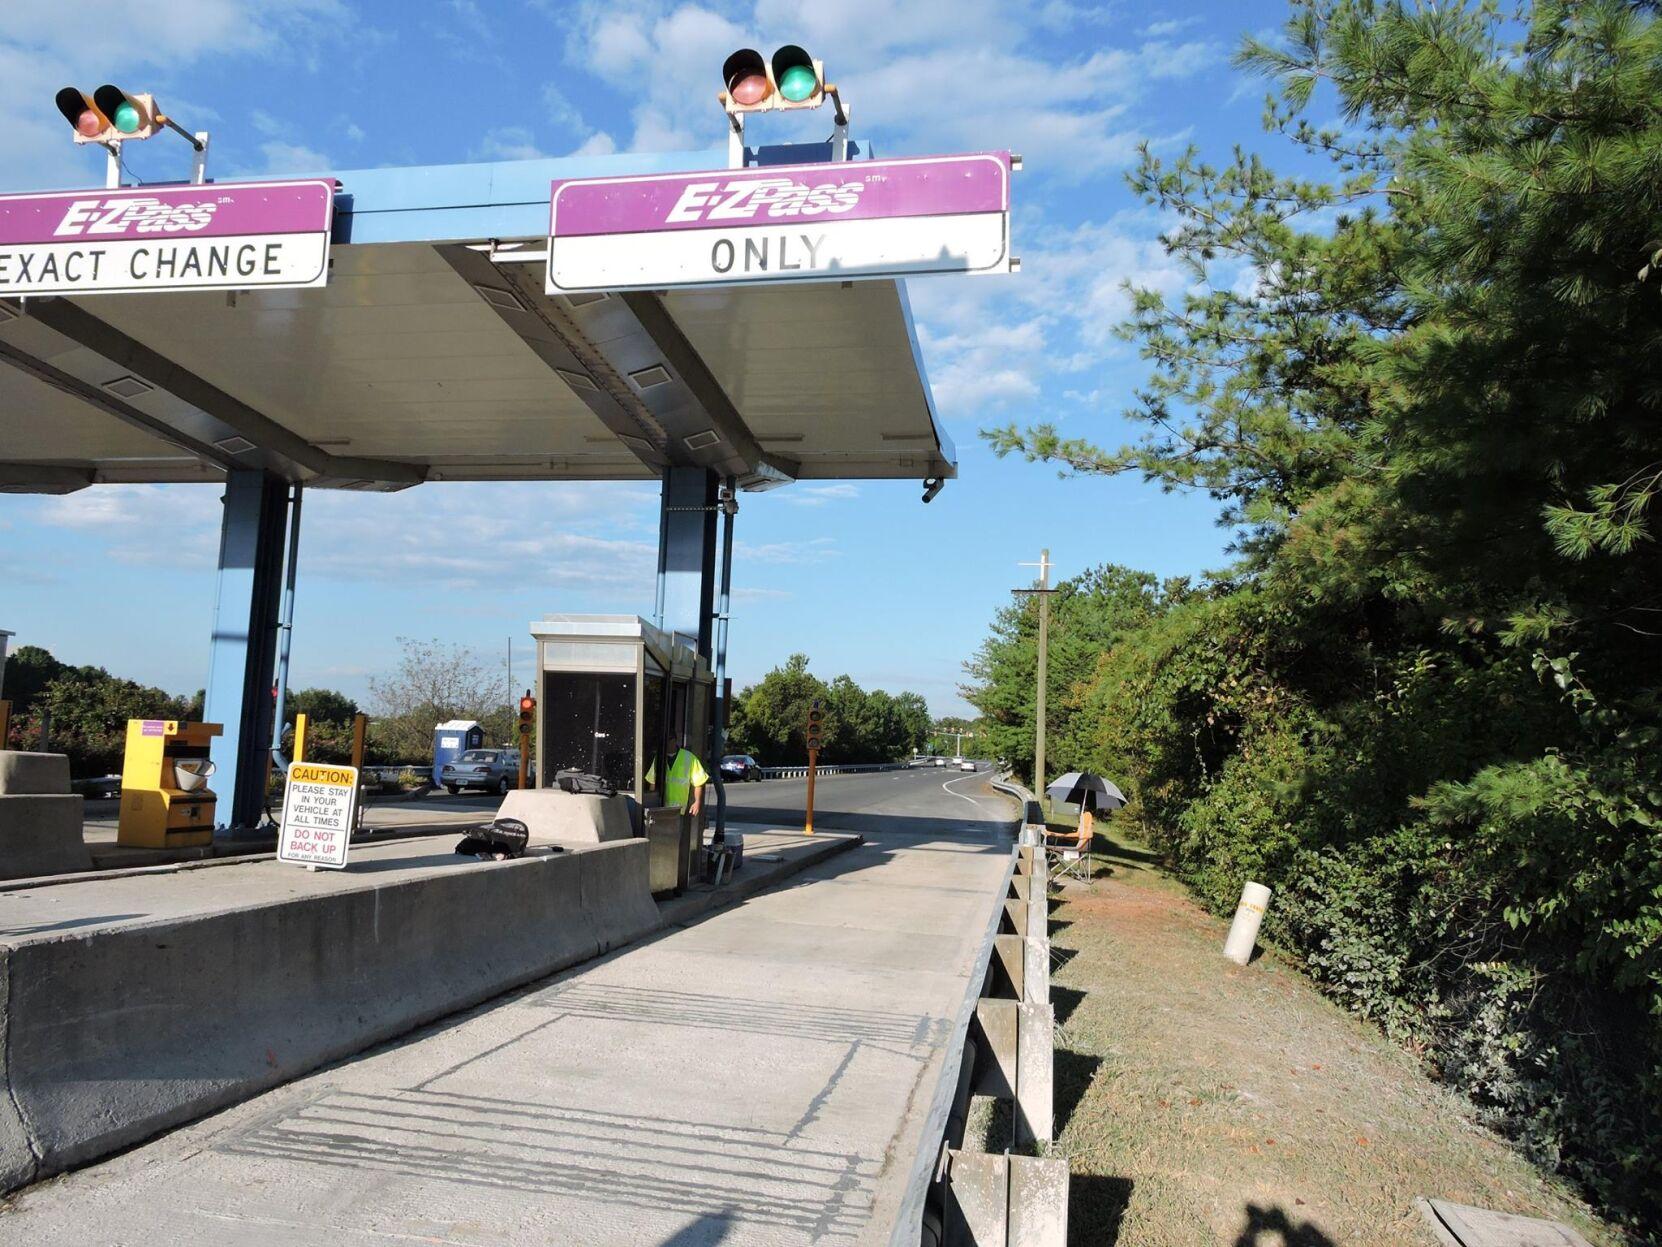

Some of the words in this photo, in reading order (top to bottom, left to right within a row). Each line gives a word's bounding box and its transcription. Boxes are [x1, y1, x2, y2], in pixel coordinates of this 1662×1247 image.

[711, 234, 826, 273] ONLY
[0, 250, 106, 284] EXACT
[131, 243, 282, 280] CHANGE
[292, 768, 353, 784] CAUTION:
[292, 785, 325, 795] PLEASE
[328, 788, 349, 797] STAY
[301, 795, 310, 803] IN
[314, 797, 337, 806] YOUR
[293, 805, 329, 815] VEHICLE
[294, 815, 309, 824] ALL
[313, 817, 339, 826] TIMES
[294, 829, 310, 838] DO
[313, 832, 335, 841] NOT
[290, 841, 318, 852] BACK
[322, 844, 336, 853] UP
